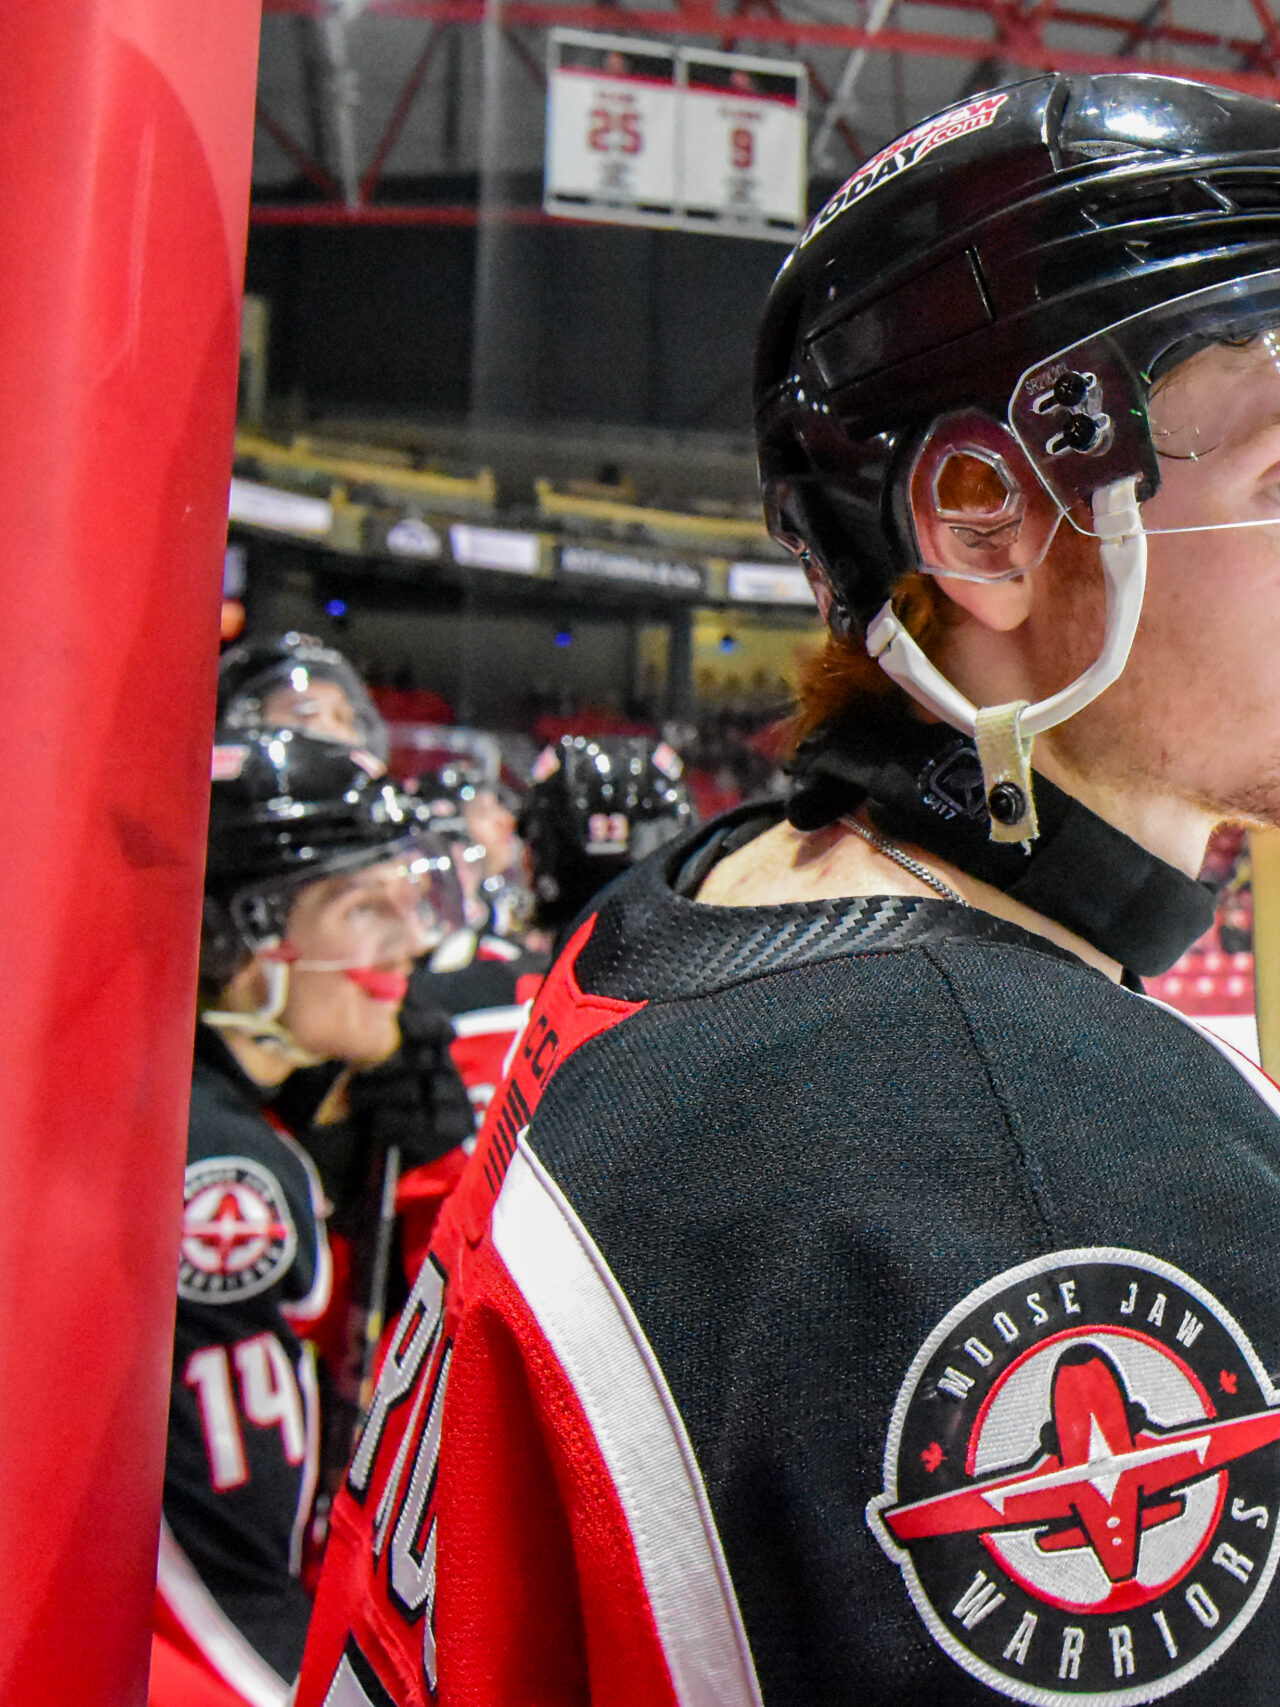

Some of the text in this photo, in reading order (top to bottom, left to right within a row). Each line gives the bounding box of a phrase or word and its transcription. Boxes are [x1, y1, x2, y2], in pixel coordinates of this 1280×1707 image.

[588, 107, 645, 156] 25
[729, 126, 755, 170] 9
[925, 112, 988, 147] .com
[936, 1279, 1204, 1400] MOOSE JAW
[181, 1331, 306, 1493] 14
[951, 1497, 1270, 1681] WARRIORS
